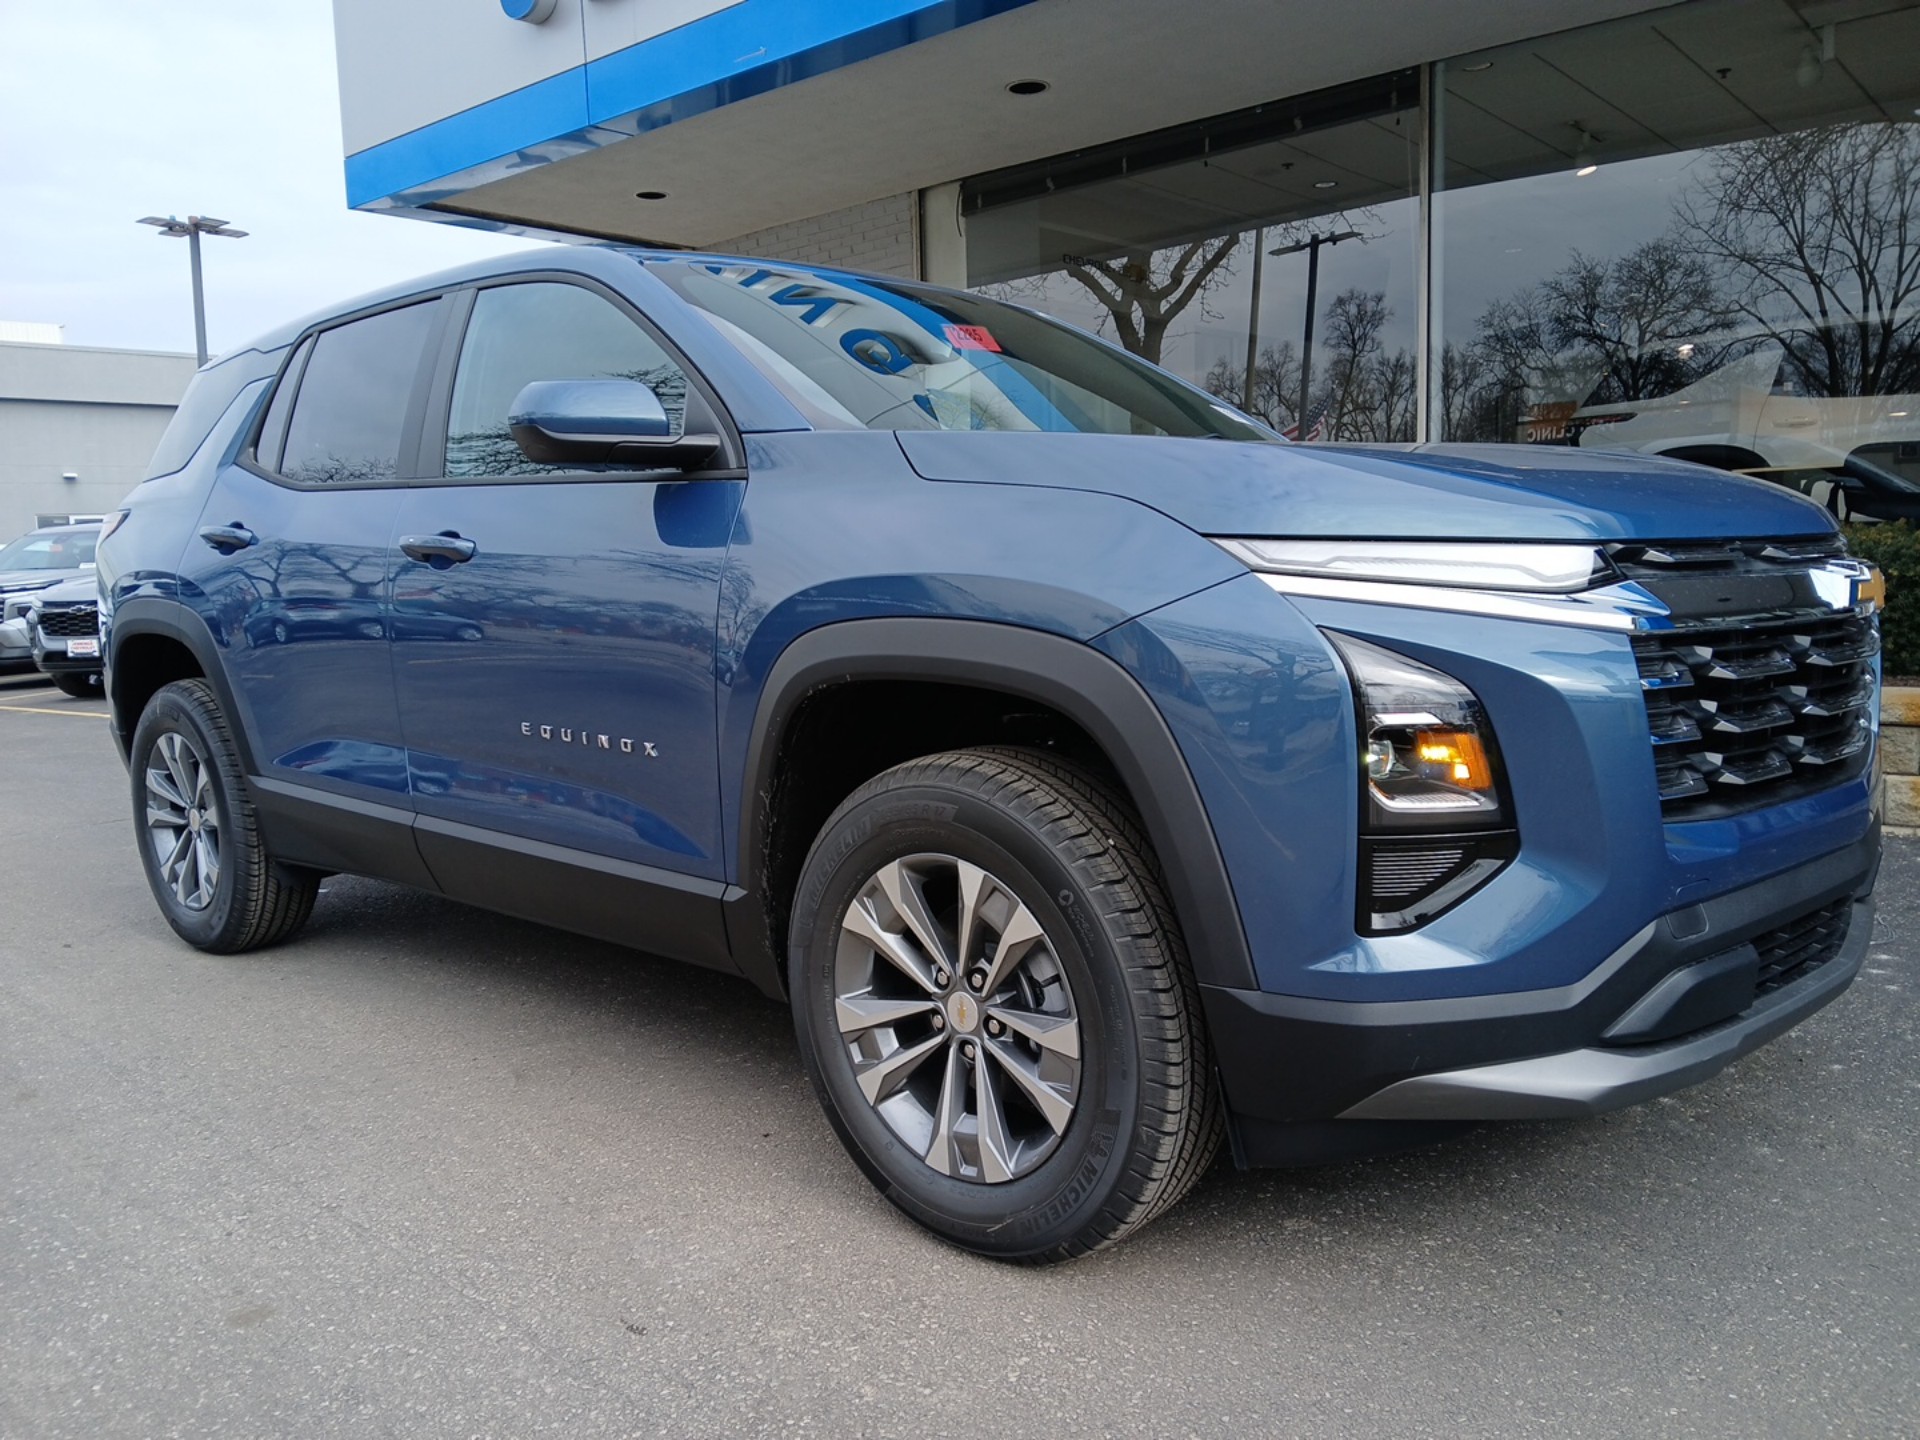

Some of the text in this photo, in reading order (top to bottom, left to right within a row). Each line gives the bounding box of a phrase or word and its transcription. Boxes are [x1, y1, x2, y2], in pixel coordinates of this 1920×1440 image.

[520, 721, 659, 757] EQUINOX
[806, 814, 873, 904] MICHELIN
[1019, 1158, 1099, 1237] MICHELIN
